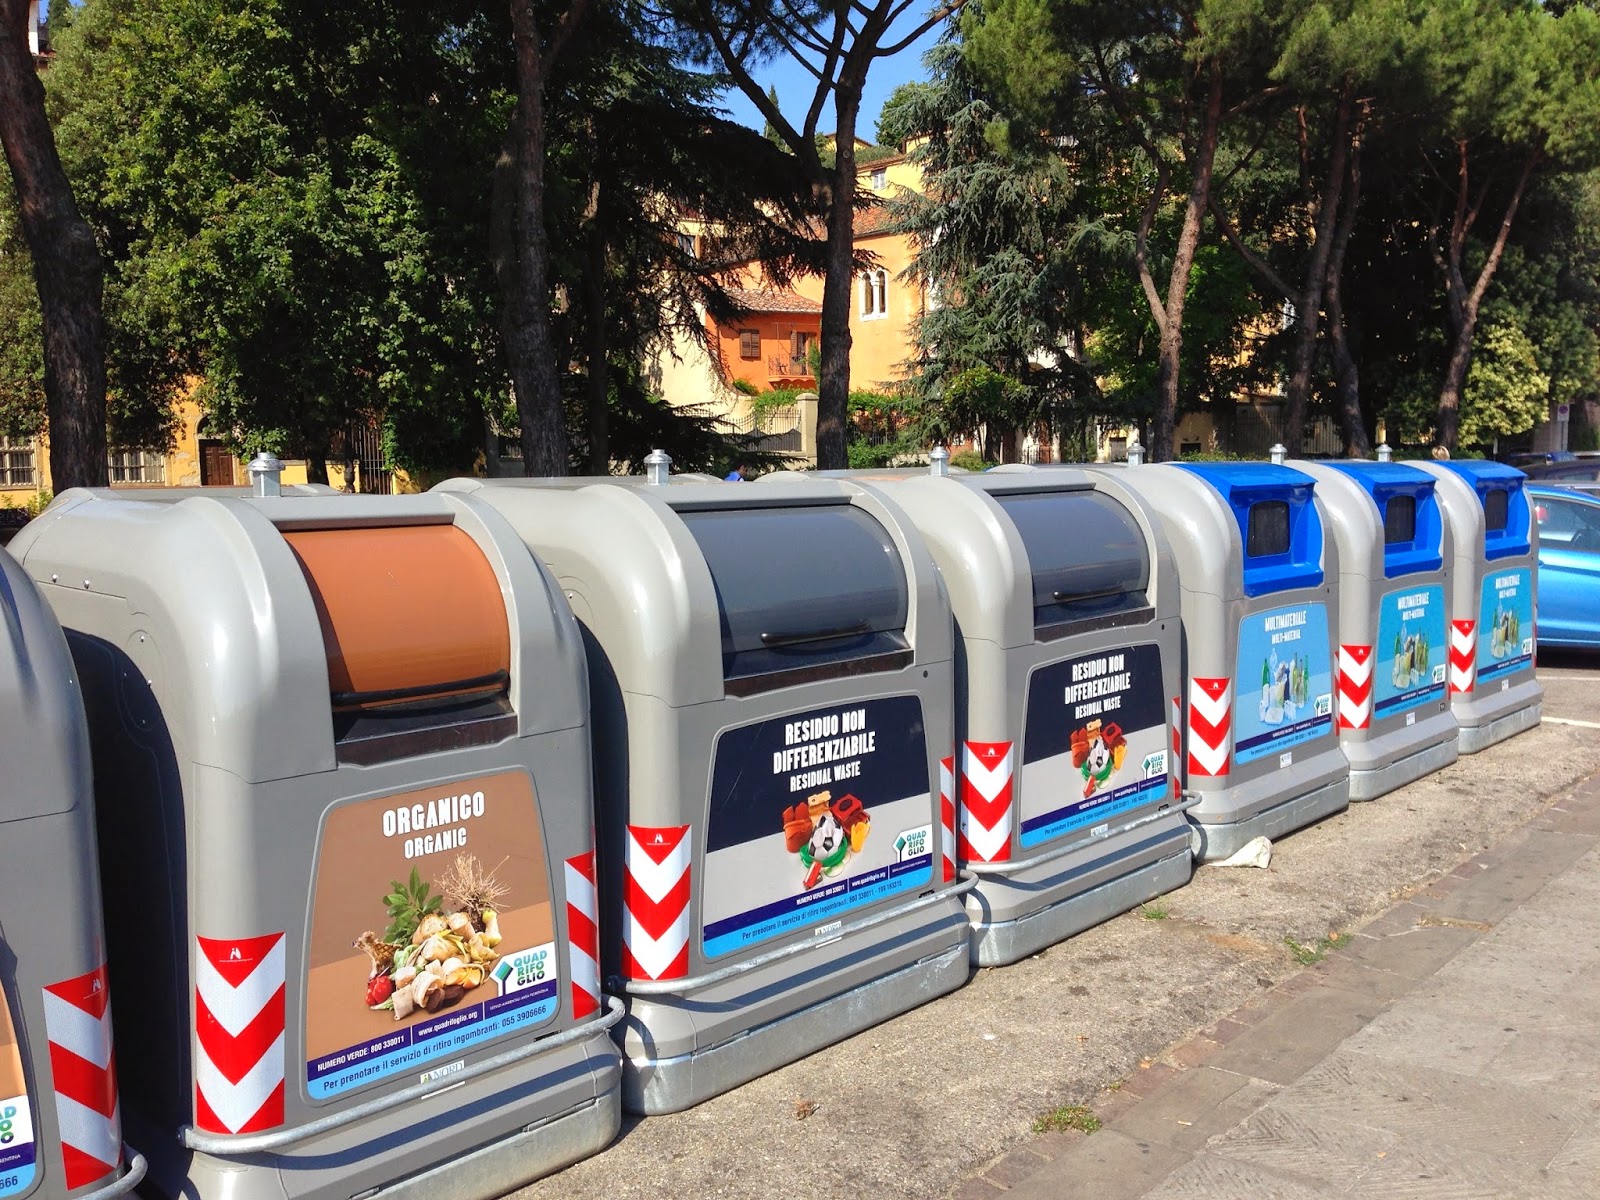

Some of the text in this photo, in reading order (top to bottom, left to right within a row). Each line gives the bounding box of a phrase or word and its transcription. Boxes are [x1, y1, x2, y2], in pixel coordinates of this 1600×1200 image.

[1264, 610, 1307, 632] MULTIMATERIALE
[1271, 629, 1301, 645] MULTI-MATERIAL
[1072, 653, 1124, 682] RESIDUO NON
[1064, 672, 1131, 705] DIFFERENZIABILE
[1075, 695, 1122, 720] RESIDUAL WASTE
[785, 708, 866, 746] RESIDUO NON
[773, 731, 876, 775] DIFFERENZIABILE
[789, 760, 861, 793] RESIDUAL WASTE
[382, 791, 485, 837] ORGANICO
[404, 827, 467, 859] ORGANIC
[906, 830, 927, 842] QUAD
[908, 838, 925, 849] RIFO
[907, 845, 925, 857] GLIO
[742, 932, 751, 940] Per
[513, 950, 548, 968] QUAD
[517, 960, 545, 977] RIFO
[516, 970, 545, 986] GLIO
[418, 1011, 478, 1037] www.quadrifoglio.org
[317, 1035, 405, 1072] NUMERO VERDE: 800 330011
[323, 1004, 547, 1091] Per prenotare il servizio di ritiro ingombranti: 055 3906666
